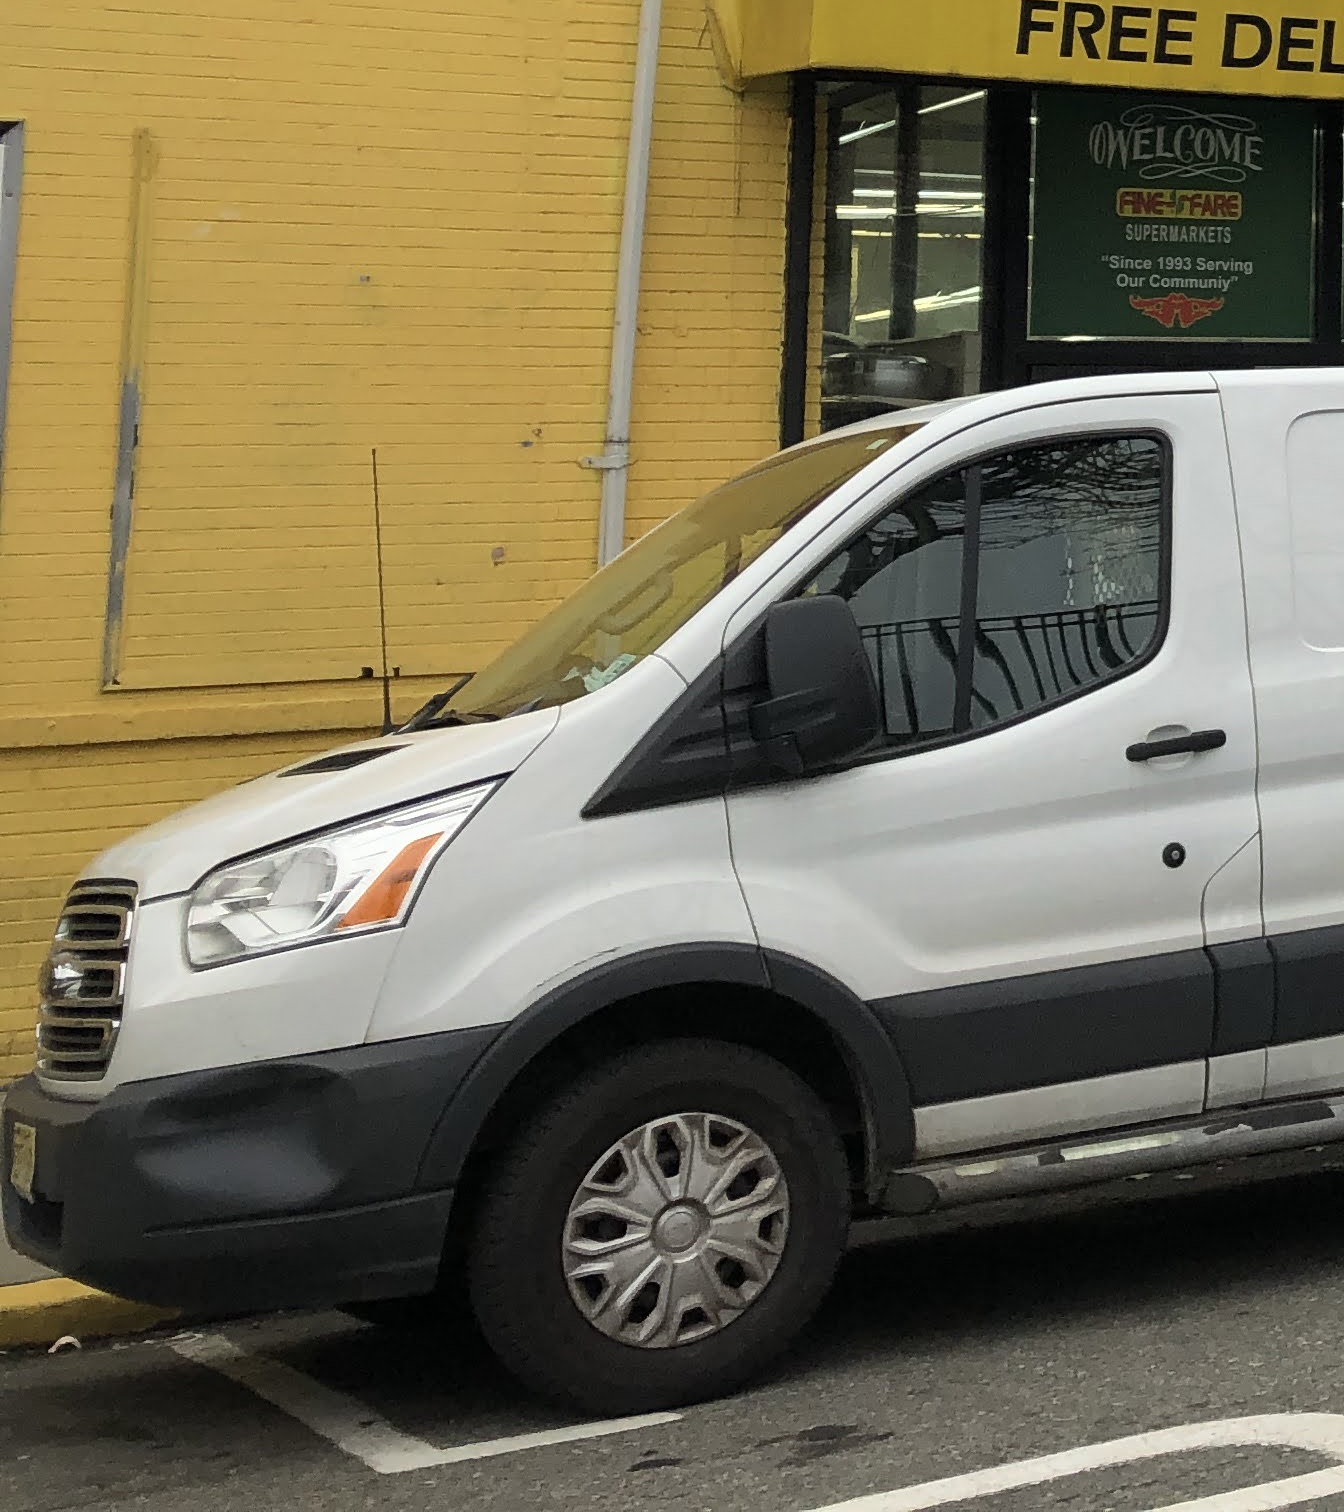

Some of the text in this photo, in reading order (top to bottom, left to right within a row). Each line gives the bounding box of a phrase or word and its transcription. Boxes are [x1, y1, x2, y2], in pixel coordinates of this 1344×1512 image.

[1089, 121, 1264, 171] WELCOME
[1119, 191, 1239, 217] FINE FARE
[1125, 223, 1232, 243] SUPERMARKETS
[1157, 256, 1192, 270] 1993
[1196, 257, 1253, 275] Serving
[1116, 273, 1146, 287] Our
